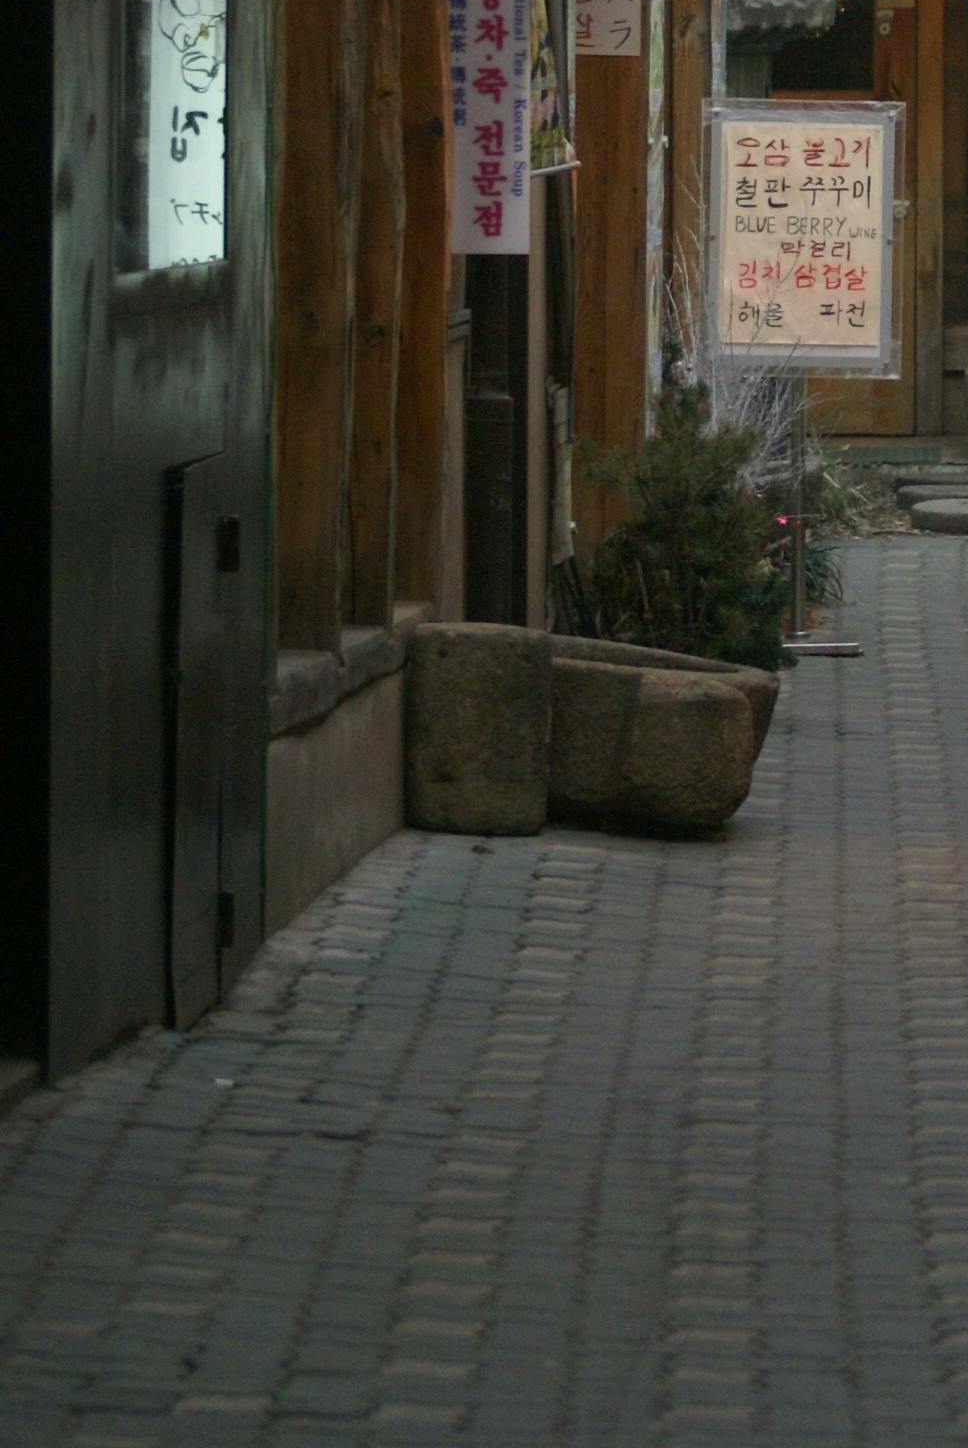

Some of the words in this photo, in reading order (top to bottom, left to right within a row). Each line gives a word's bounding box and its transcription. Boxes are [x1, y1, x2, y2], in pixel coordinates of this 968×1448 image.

[513, 99, 527, 153] Korean
[735, 137, 790, 167] 오삼
[802, 137, 871, 169] 불고기
[472, 120, 507, 238] 전문점
[511, 161, 527, 197] Soup
[735, 177, 791, 208] 철판
[735, 216, 776, 234] BLUE
[786, 216, 847, 236] BERRY
[849, 226, 877, 239] WINE
[780, 240, 851, 262] 막걸리
[738, 260, 780, 290] 김치
[793, 263, 868, 291] 삼겹살
[820, 303, 866, 328] 파전
